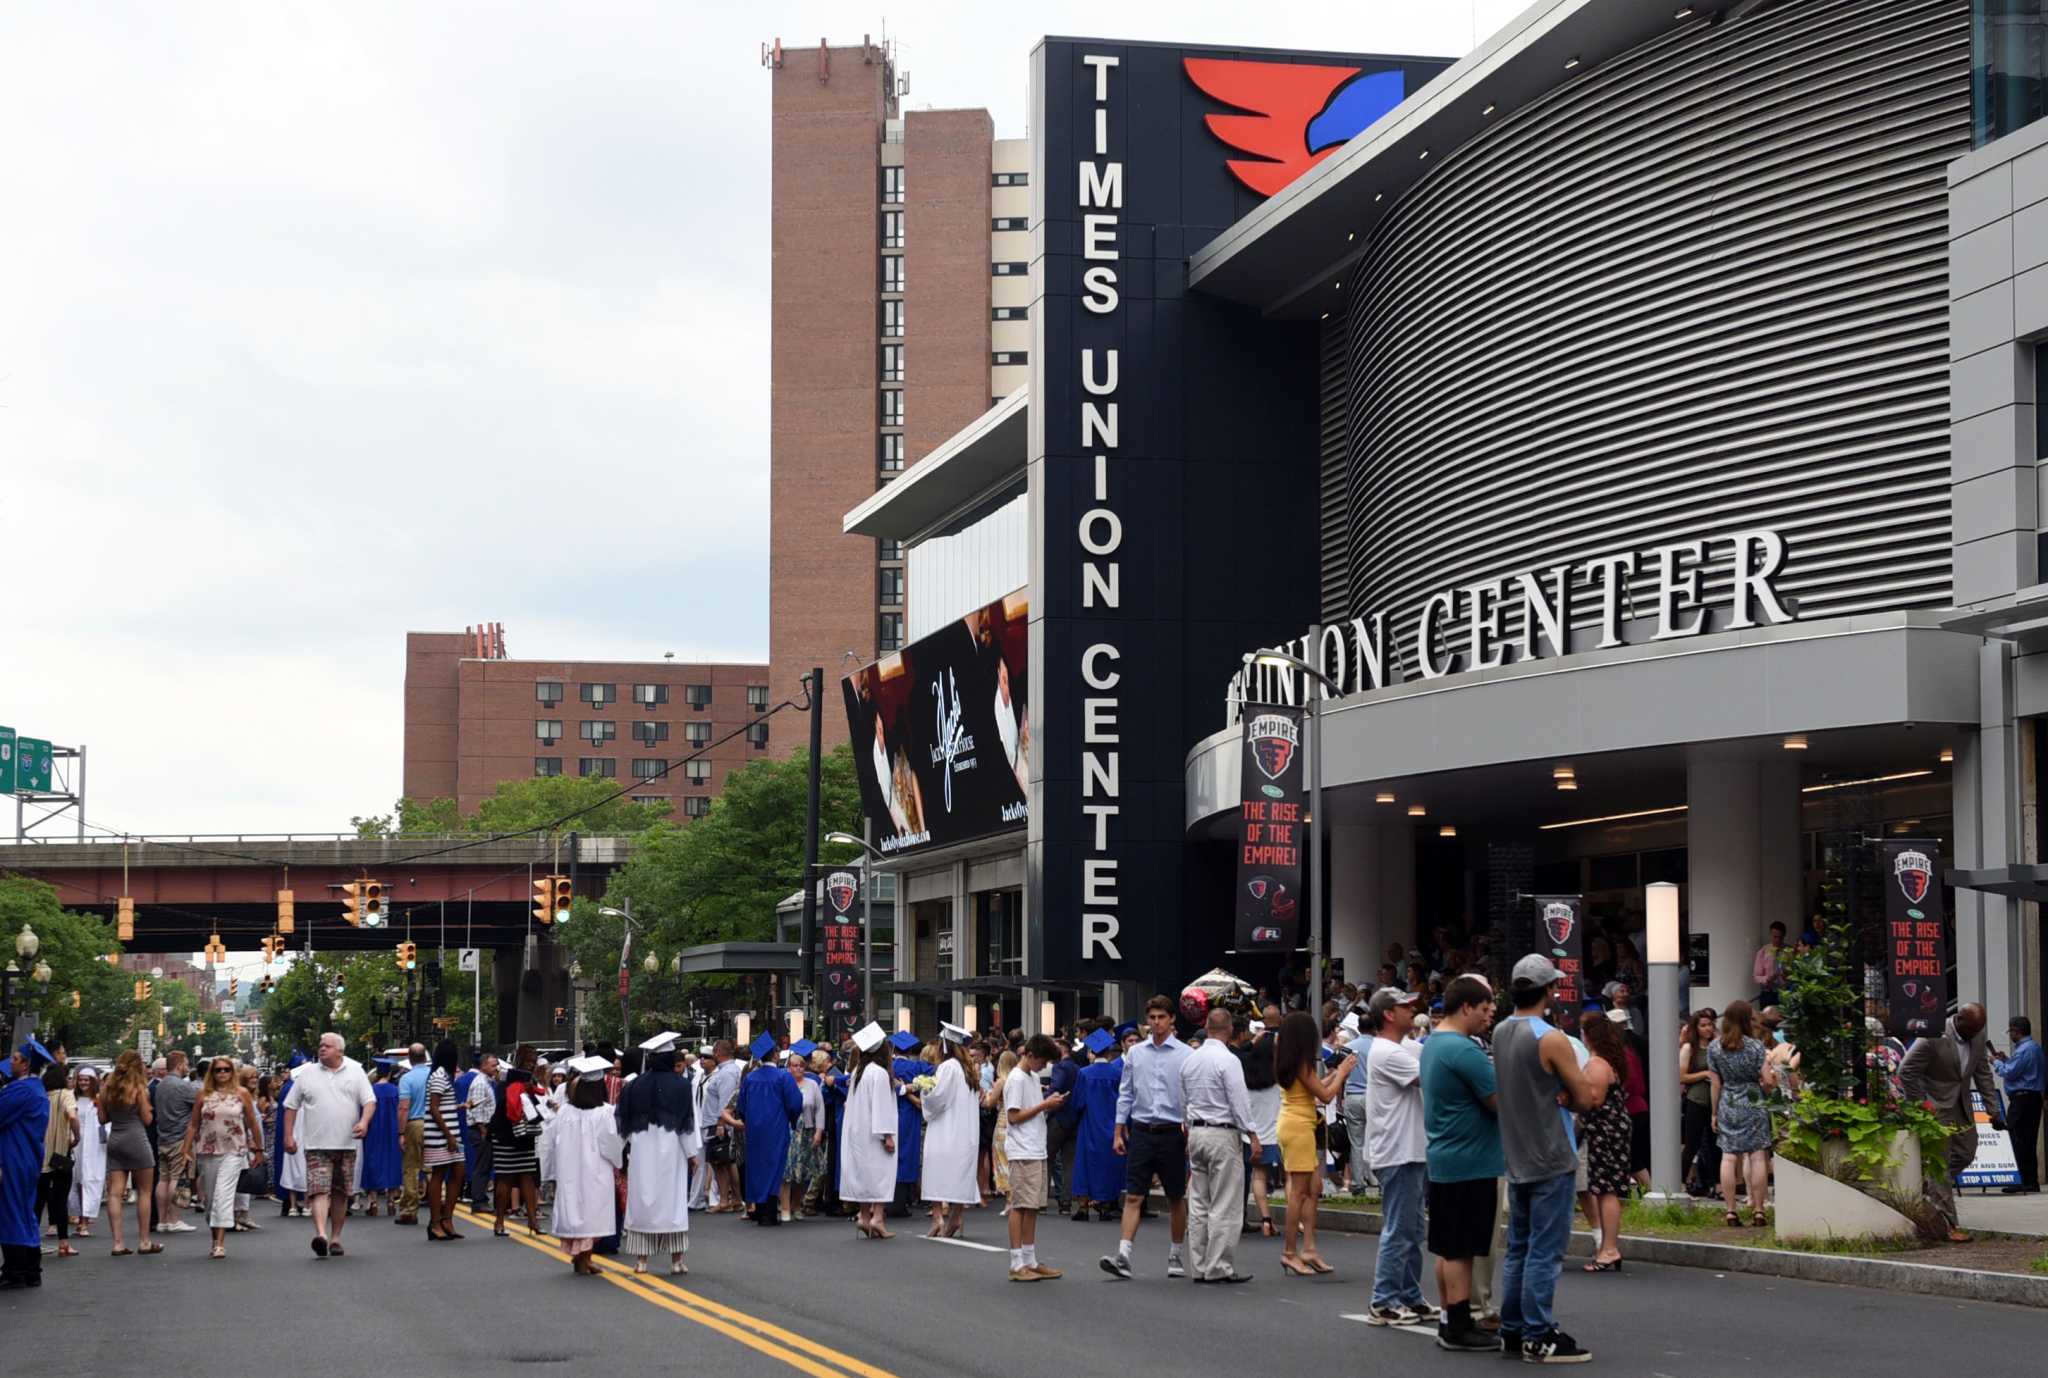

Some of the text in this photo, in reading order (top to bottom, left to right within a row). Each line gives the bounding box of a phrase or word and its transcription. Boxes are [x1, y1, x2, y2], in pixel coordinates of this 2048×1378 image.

[1078, 55, 1122, 959] TIMES UNION CENTER
[1418, 530, 1794, 680] CENTER
[1251, 720, 1296, 740] EMPIRE
[1243, 801, 1299, 822] THE RISE
[1247, 824, 1292, 843] OF THE
[1244, 846, 1296, 865] EMPIRE!
[1897, 857, 1930, 871] EMPIRE
[824, 926, 858, 938] THE RISE
[1891, 921, 1940, 938] THE RISE
[828, 939, 855, 951] OF THE
[1896, 941, 1936, 956] OF THE
[826, 952, 857, 965] EMPIRE!
[1895, 960, 1941, 976] EMPIRE!
[1962, 1174, 2015, 1184] STOP IN TODAY
